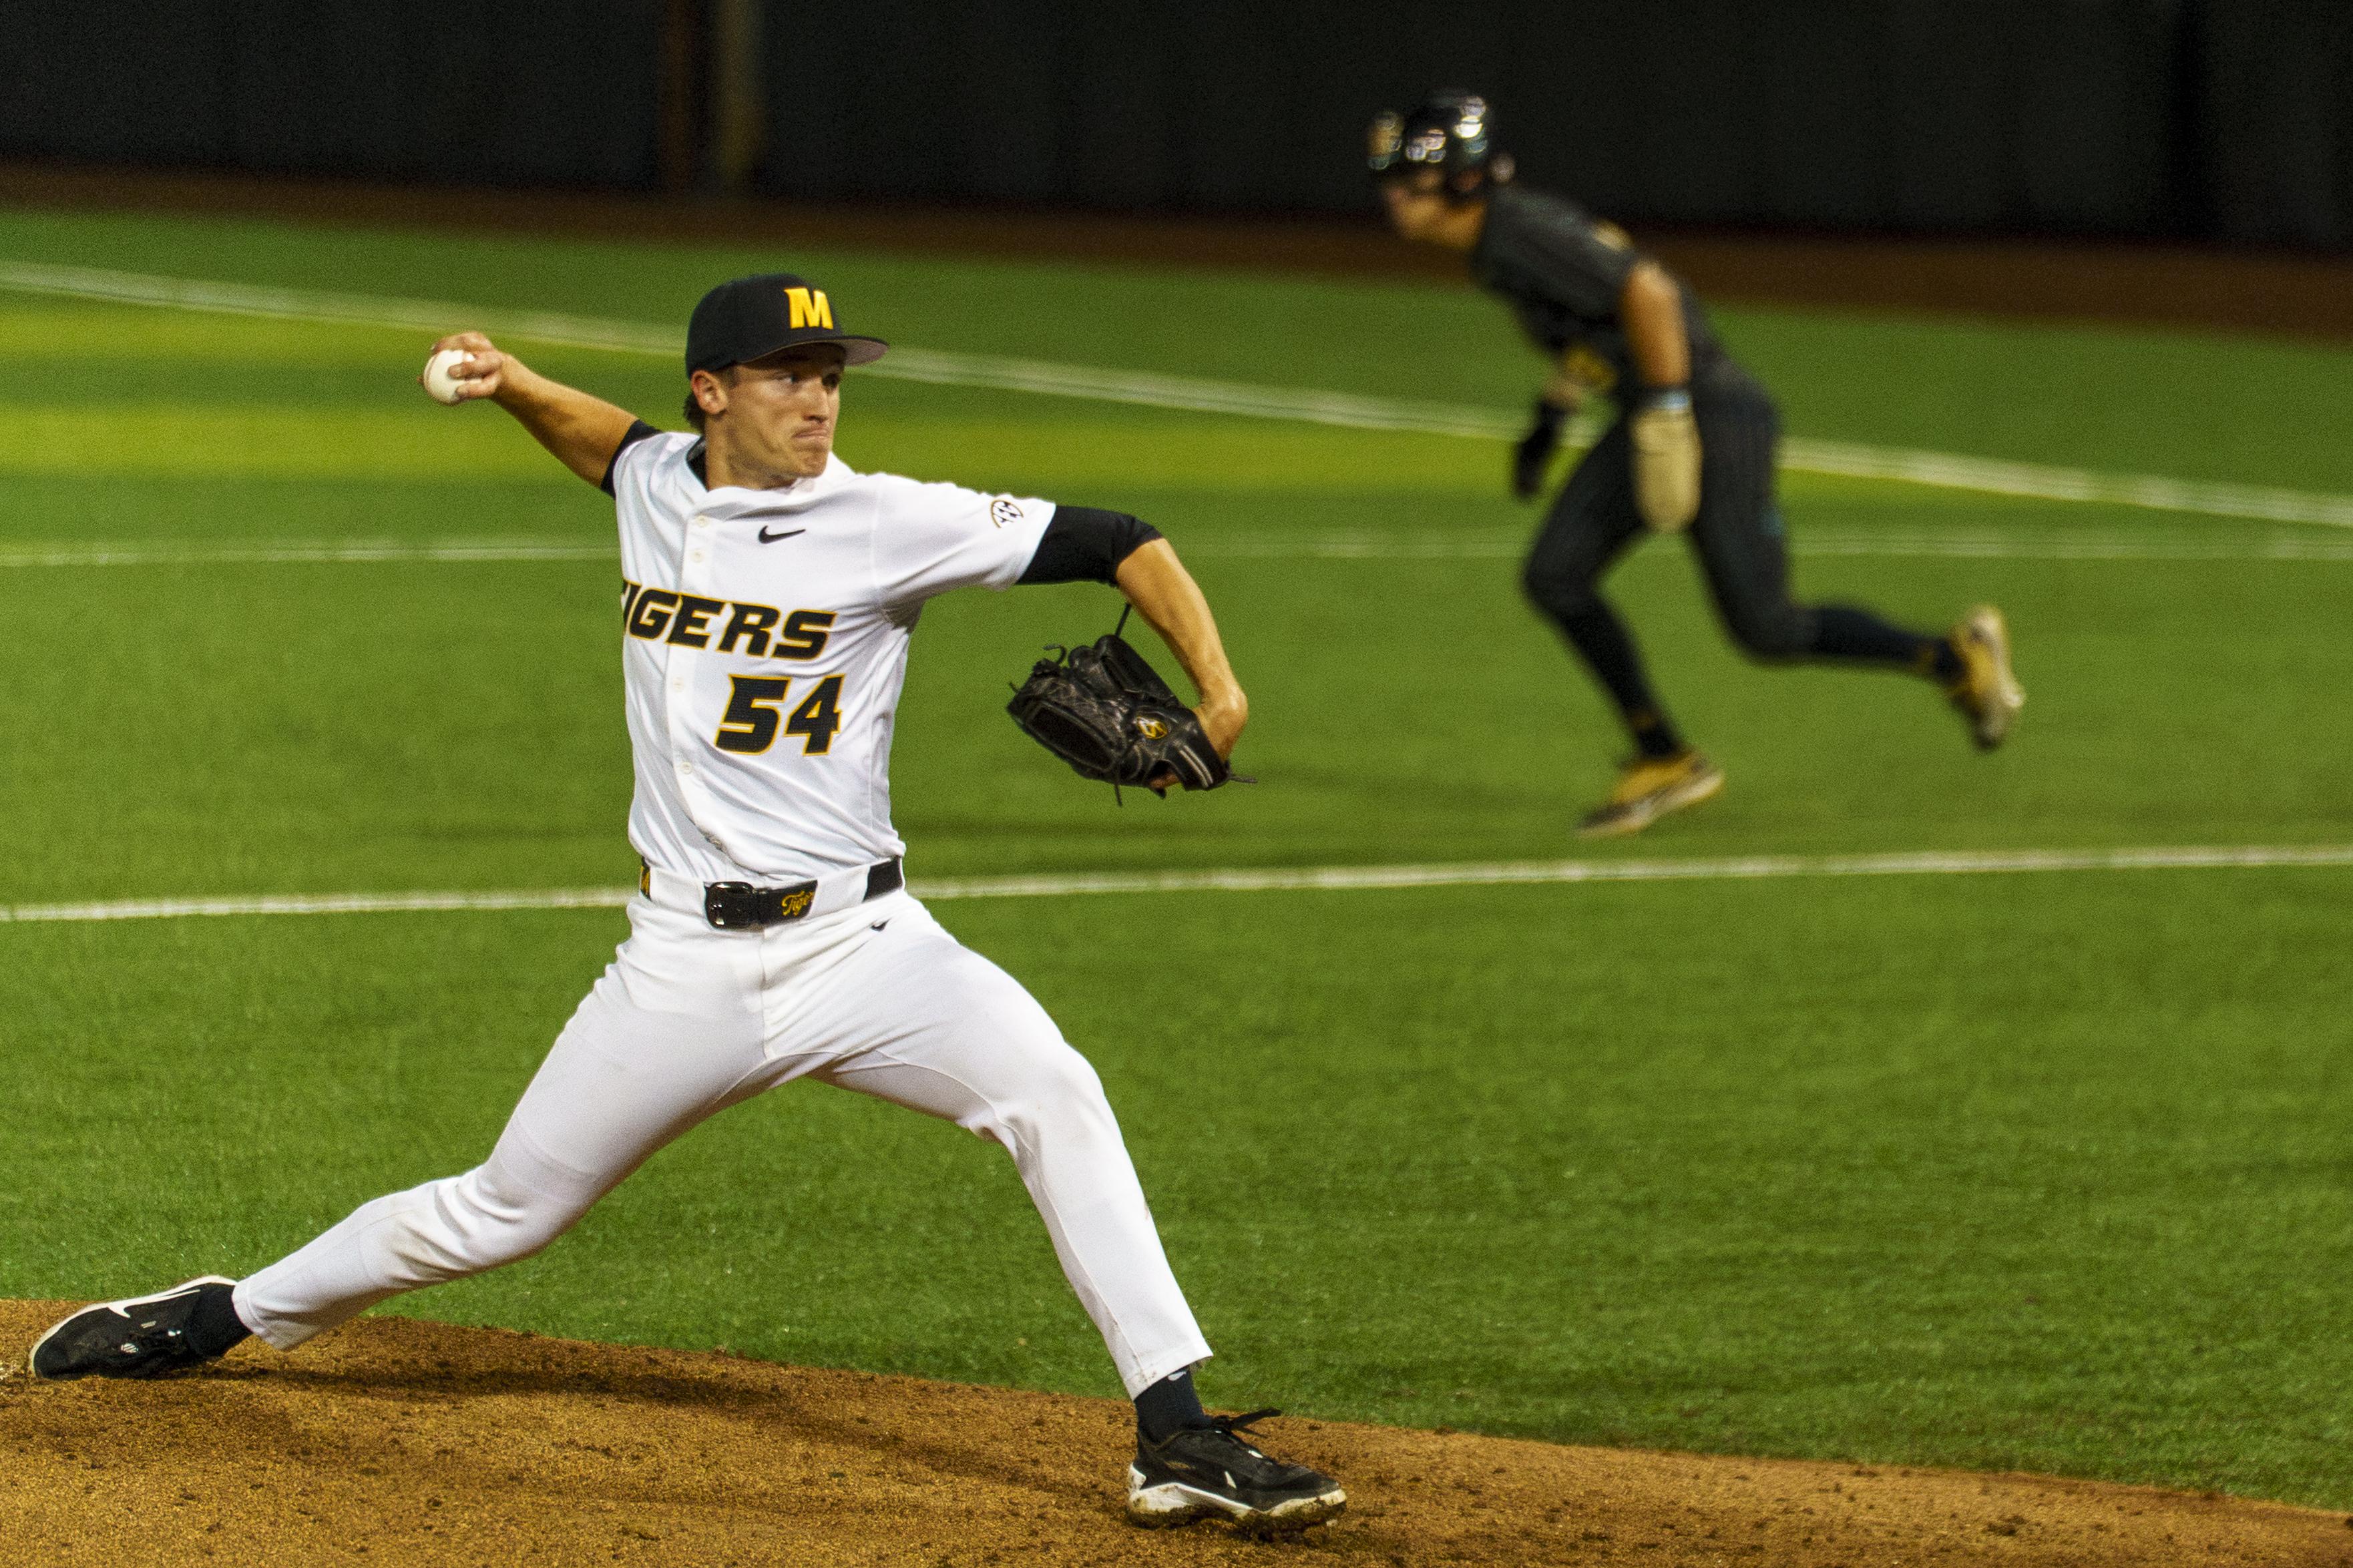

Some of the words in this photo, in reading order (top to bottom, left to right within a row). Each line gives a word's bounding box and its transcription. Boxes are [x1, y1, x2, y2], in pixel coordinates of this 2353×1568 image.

[784, 286, 834, 330] M
[622, 579, 837, 661] IGERS
[716, 674, 846, 756] 54
